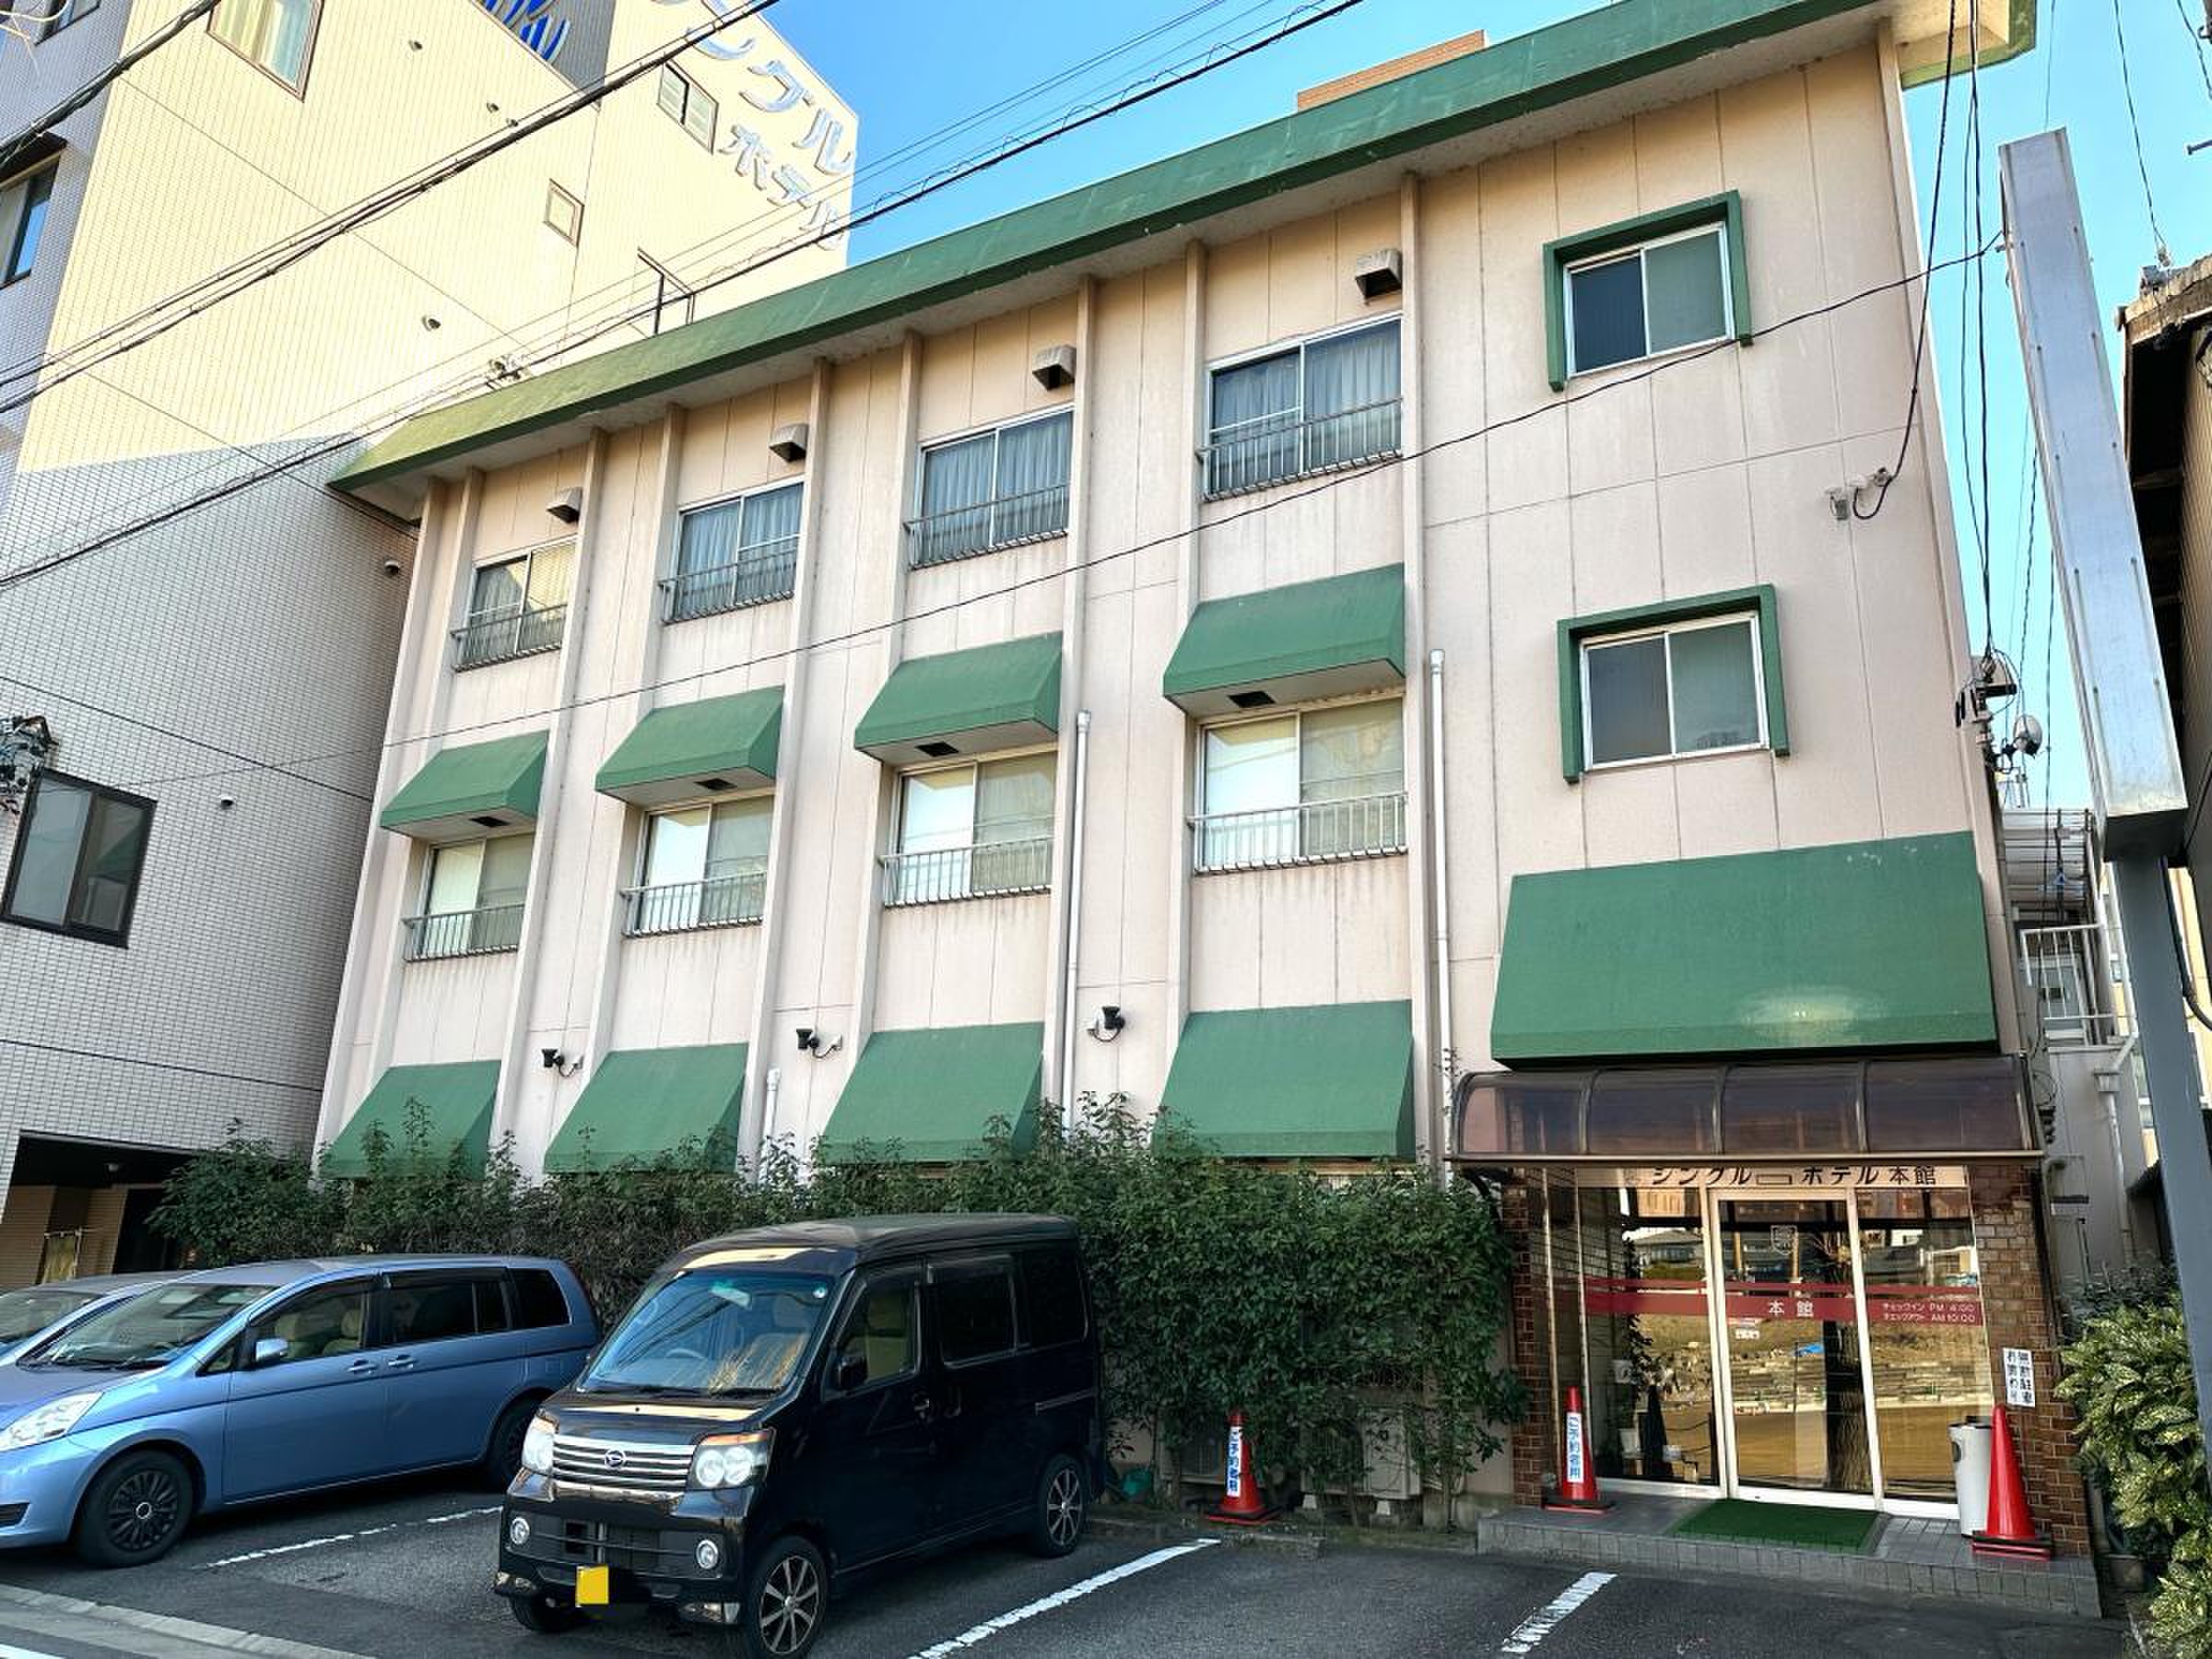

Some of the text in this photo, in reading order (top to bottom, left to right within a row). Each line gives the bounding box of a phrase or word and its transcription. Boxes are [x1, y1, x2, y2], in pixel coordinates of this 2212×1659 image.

[648, 0, 853, 175] ングル
[717, 124, 845, 252] ホテル
[1652, 1165, 1936, 1186] シングル ホテル 本館
[1767, 1300, 1815, 1318] 本館
[1930, 1302, 1945, 1312] PM
